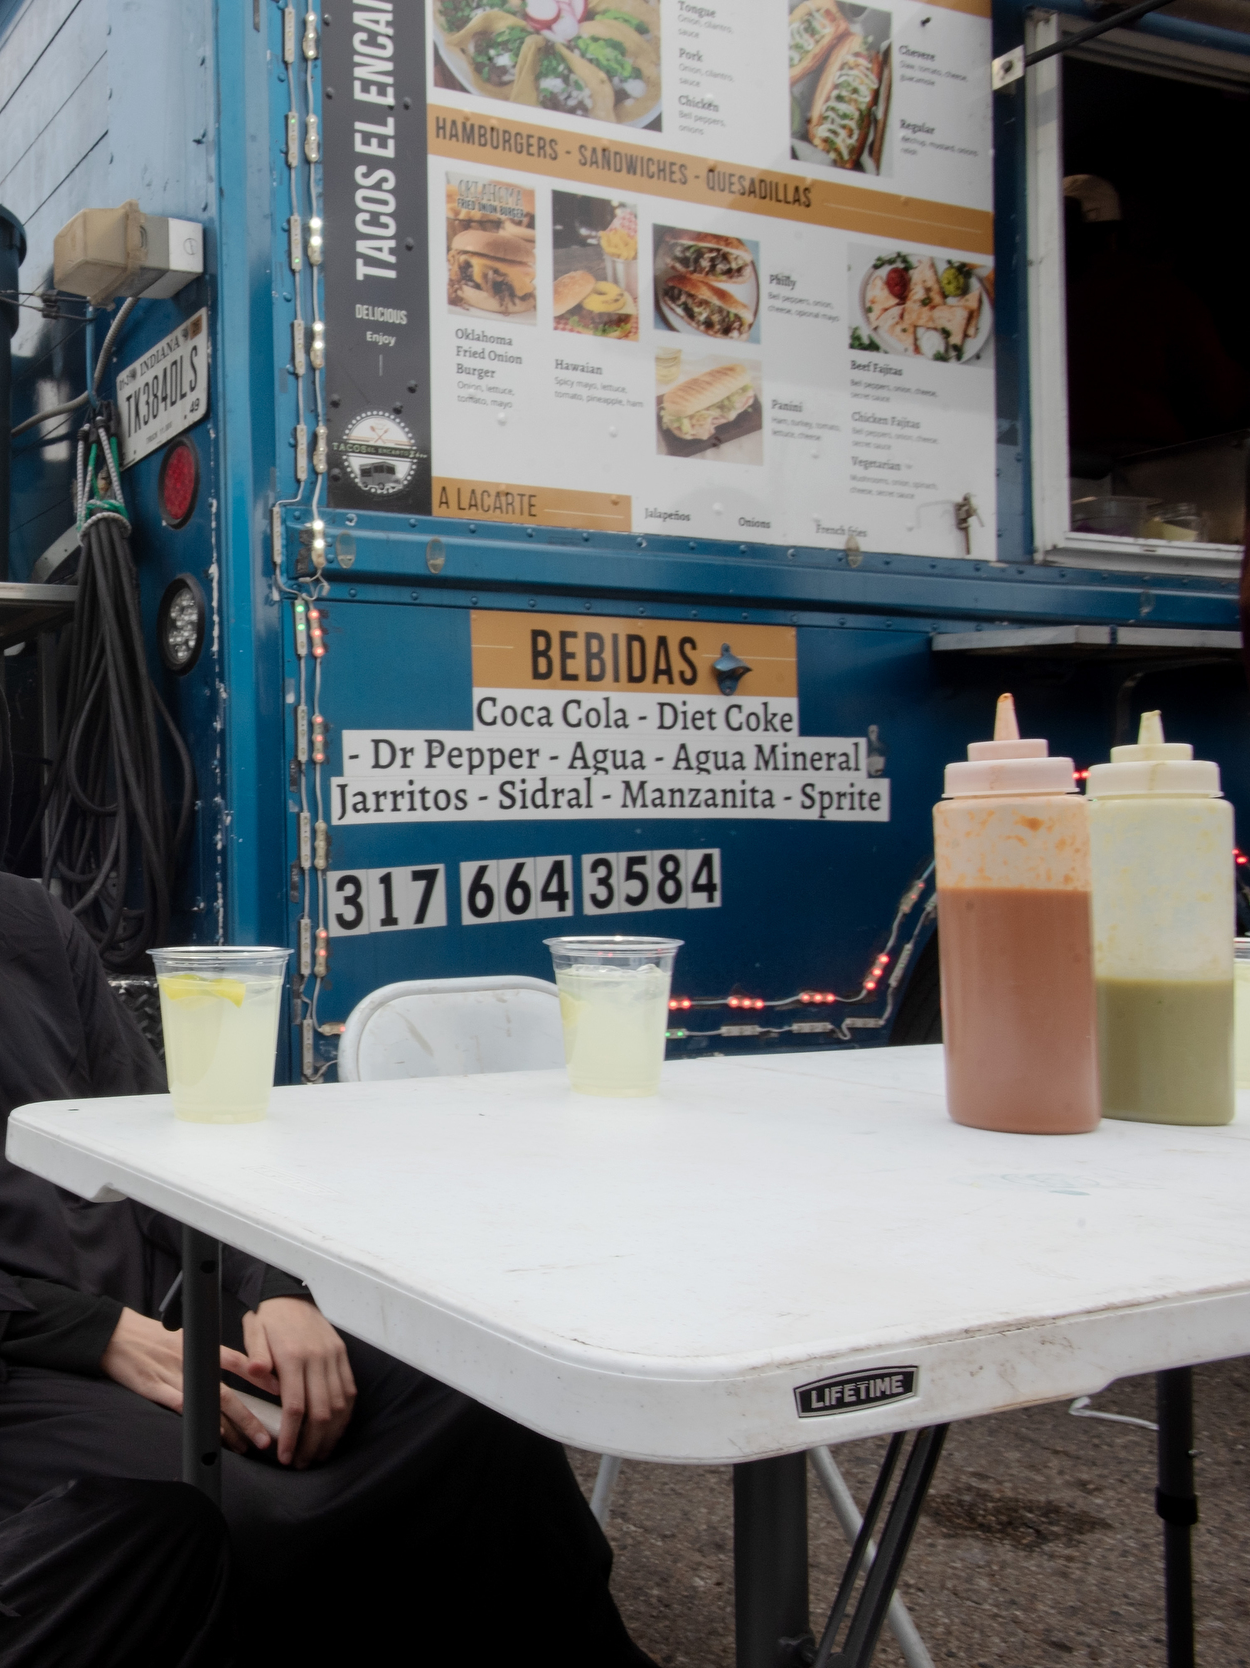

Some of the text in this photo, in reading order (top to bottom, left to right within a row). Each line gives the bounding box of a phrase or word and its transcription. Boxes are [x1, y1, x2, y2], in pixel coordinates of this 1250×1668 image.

[678, 0, 716, 18] Tongue
[679, 47, 704, 62] Pork
[678, 94, 720, 112] Chicken
[354, 117, 395, 158] EL
[435, 115, 558, 161] HAMBURGERS
[578, 144, 688, 185] SANDWICHES
[706, 168, 812, 208] QUESADILLAS
[499, 205, 525, 220] BURGER
[354, 165, 397, 281] TACOS
[769, 273, 797, 291] Philly
[355, 304, 407, 325] DELICIOUS
[366, 331, 396, 347] Enjoy
[455, 328, 513, 346] Oklahoma
[140, 336, 181, 377] INDIANA
[456, 345, 523, 365] Fried Onion
[456, 363, 496, 380] Burger
[555, 359, 603, 375] Hawaian
[850, 360, 872, 371] Beef
[189, 397, 200, 413] 49
[490, 399, 513, 410] mayo
[772, 399, 803, 413] Panini
[851, 411, 888, 425] Chicken
[332, 443, 367, 453] TACOS
[851, 456, 901, 471] Vegetarian
[439, 486, 537, 517] A LACARTE
[644, 507, 690, 522] Jalapeños
[738, 517, 771, 529] Onions
[531, 629, 697, 686] BEBIDAS
[476, 696, 554, 727] Coca
[562, 696, 630, 729] Cola
[657, 701, 717, 731] Diet
[724, 701, 793, 733] Coke
[371, 739, 415, 770] Dr
[424, 739, 540, 775] Pepper
[568, 741, 646, 775] Agua
[672, 743, 747, 775] Agua
[754, 742, 861, 771] Mineral
[336, 779, 469, 820] Jarritos
[499, 776, 594, 810] Sidral
[620, 779, 776, 809] Manzanita
[800, 782, 882, 819] Sprite
[335, 853, 719, 930] 317 664 3584
[810, 1374, 904, 1409] LIFETIME
